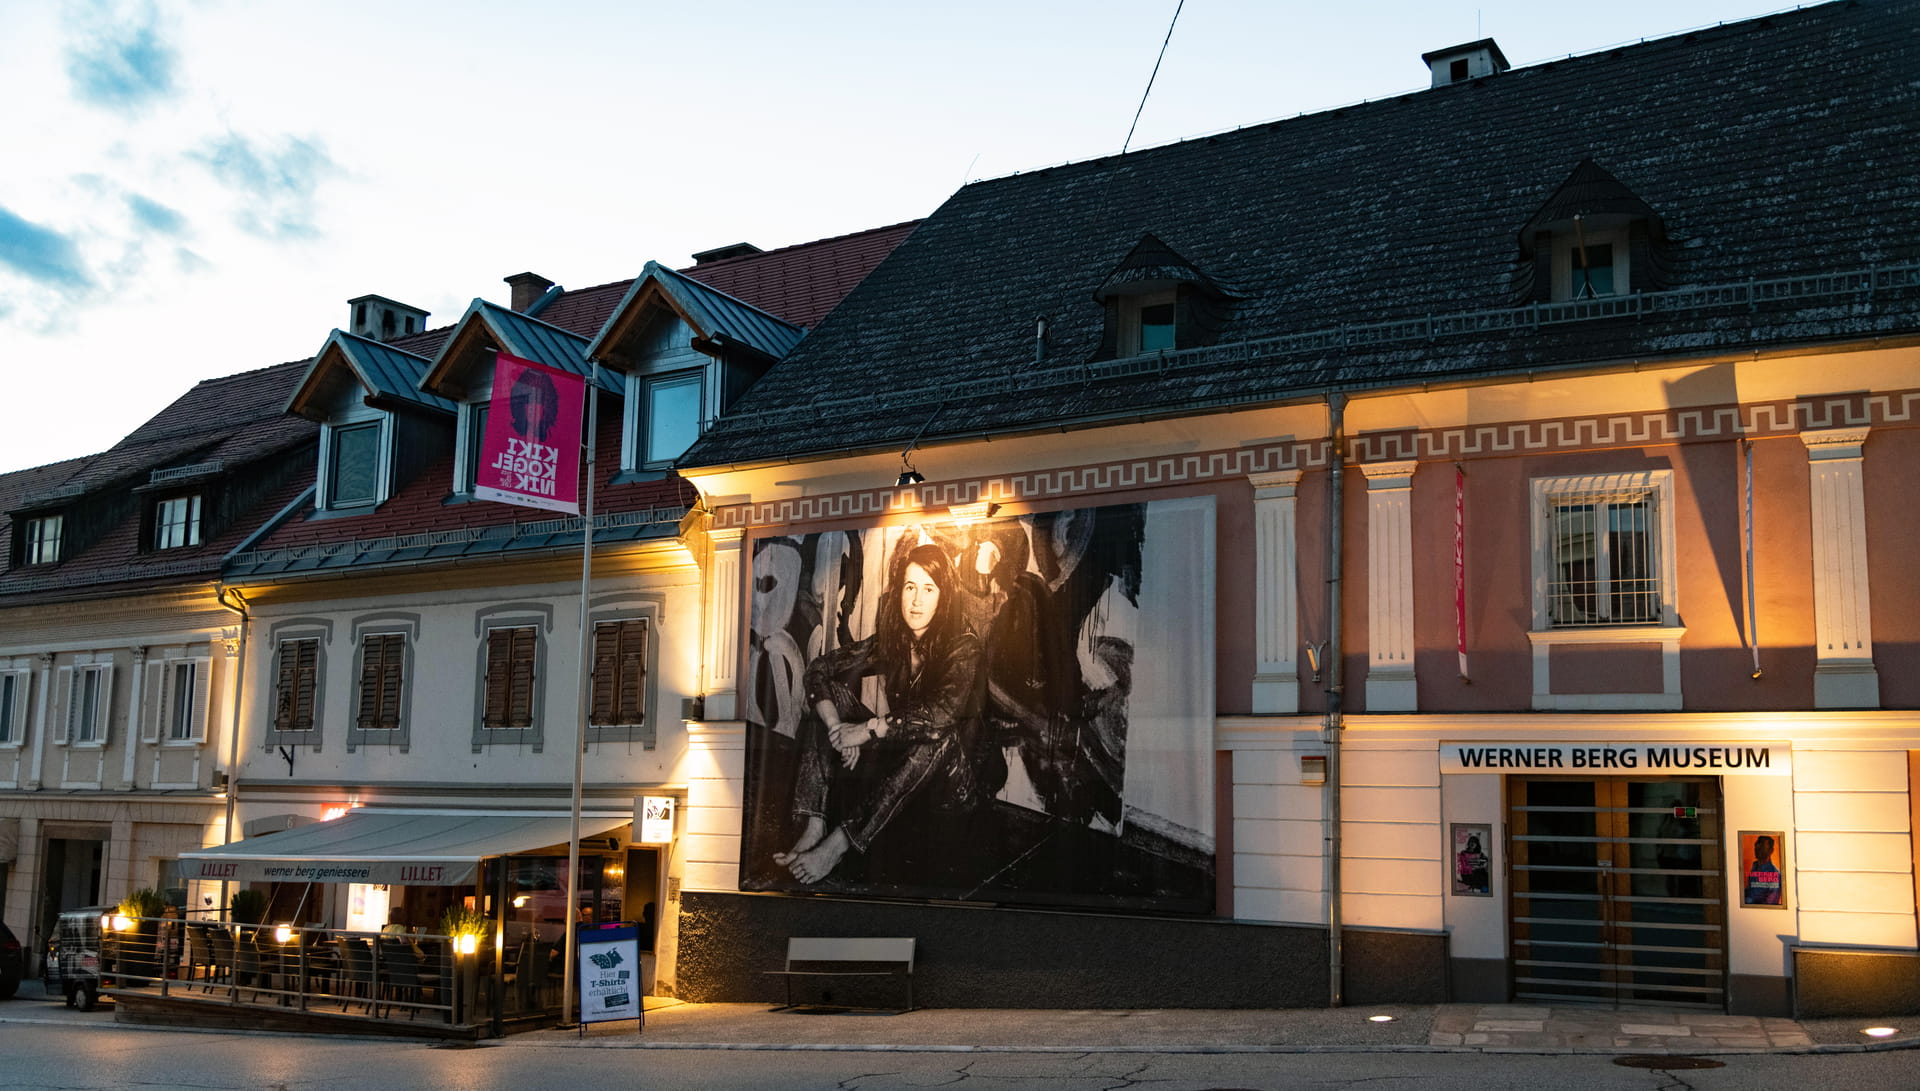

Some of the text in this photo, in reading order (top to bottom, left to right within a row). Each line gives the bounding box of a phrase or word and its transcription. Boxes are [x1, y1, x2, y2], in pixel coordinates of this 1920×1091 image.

[1458, 747, 1770, 769] WERNER BERG MUSEUM
[200, 863, 238, 877] LILLET
[264, 864, 371, 880] werner berg geniesserei
[400, 866, 444, 881] LILLET
[590, 979, 626, 987] T-Shirts
